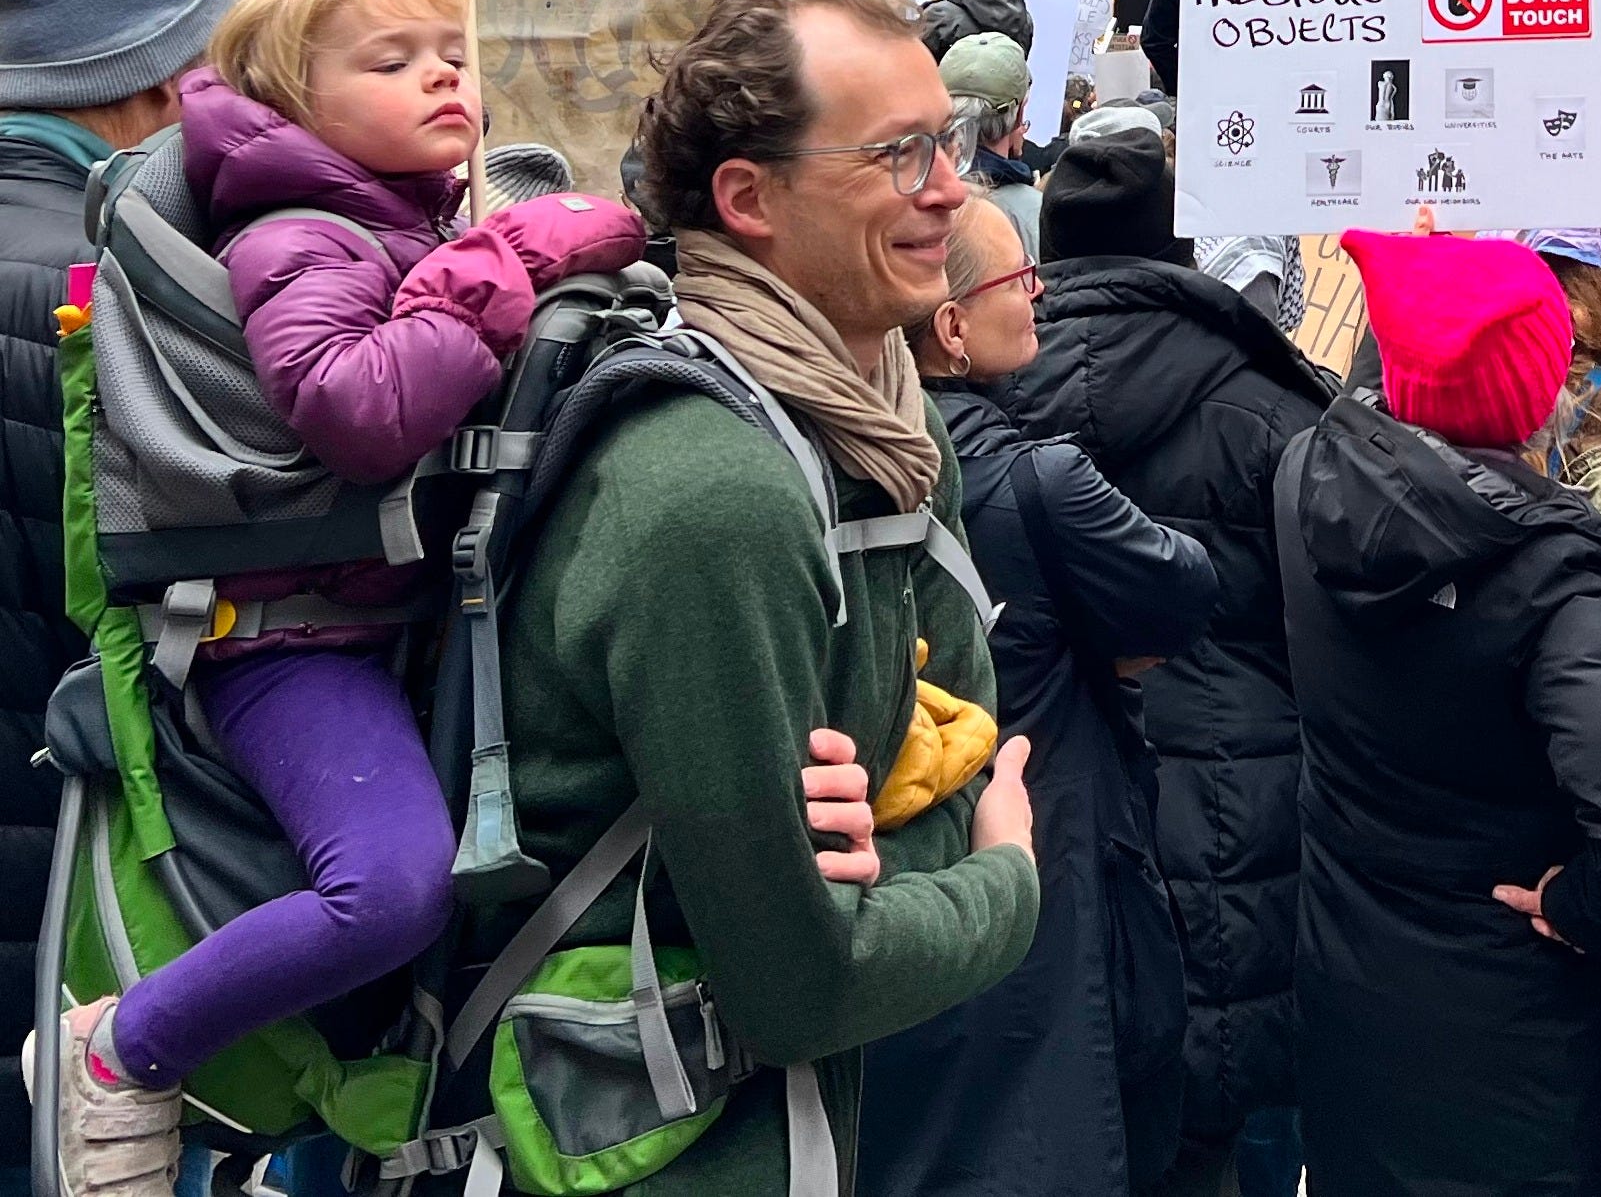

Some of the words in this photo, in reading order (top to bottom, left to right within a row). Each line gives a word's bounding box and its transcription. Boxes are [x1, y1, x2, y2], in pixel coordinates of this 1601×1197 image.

[1509, 9, 1583, 27] TOUCH
[1212, 13, 1386, 48] OBJECTS
[1444, 121, 1497, 129] UNIVERSITIES
[1562, 152, 1584, 160] ARTS
[1214, 160, 1252, 168] SCIENCE
